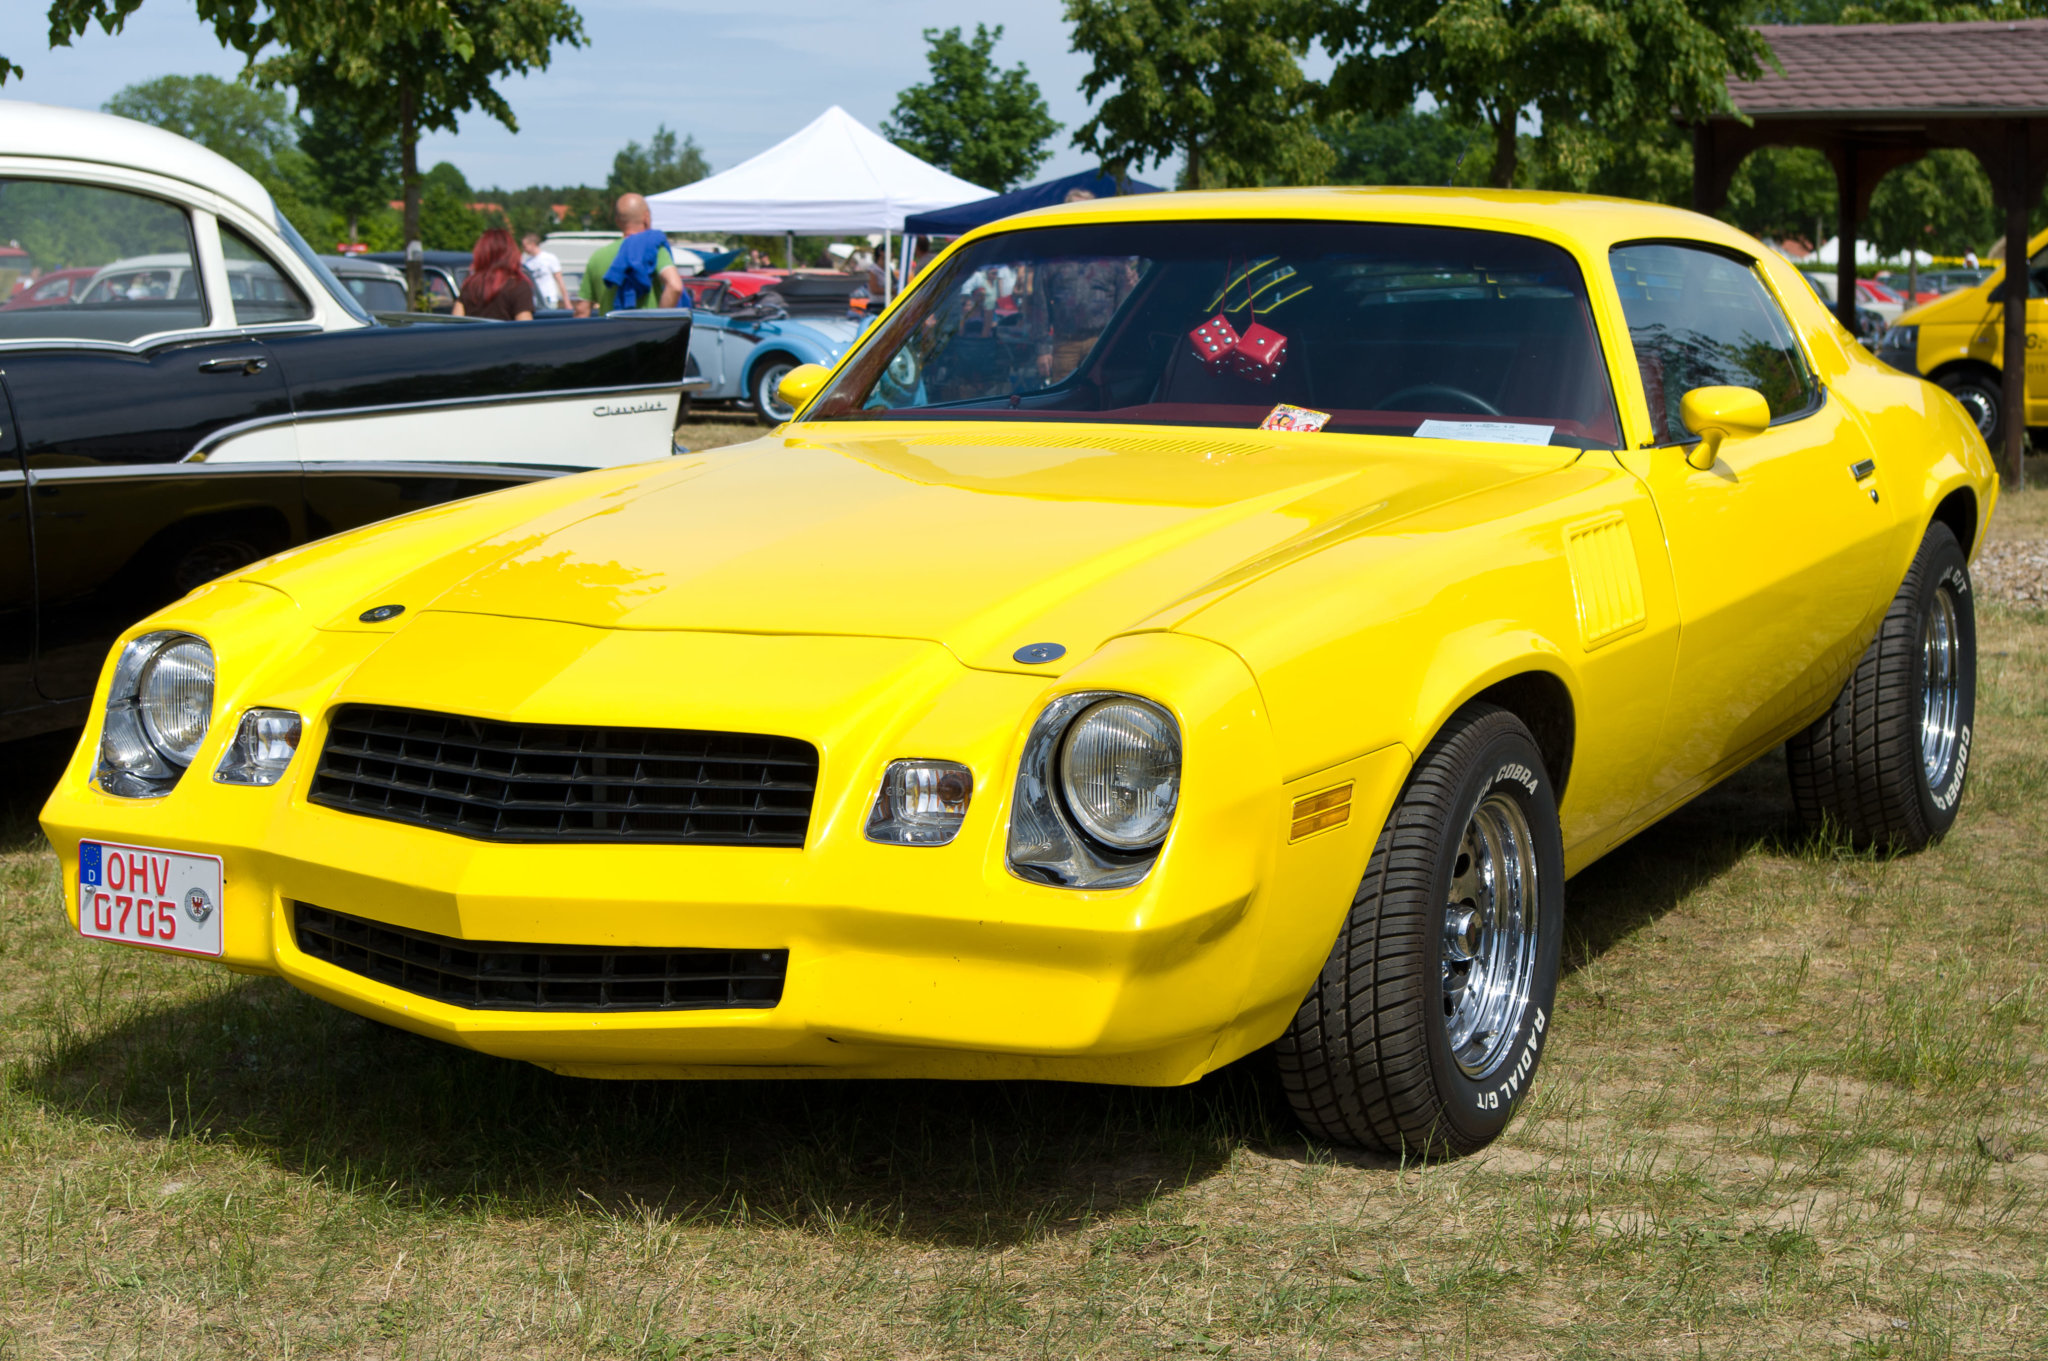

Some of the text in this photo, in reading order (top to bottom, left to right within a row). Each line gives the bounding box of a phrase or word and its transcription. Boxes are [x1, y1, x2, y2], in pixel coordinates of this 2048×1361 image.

[593, 401, 668, 417] Chevrolet
[1495, 763, 1539, 796] COBRA
[1944, 725, 1971, 808] COOPER
[88, 869, 97, 882] D
[107, 852, 170, 896] OHV
[94, 893, 176, 940] 0705
[1476, 1007, 1546, 1110] RADIAL G/T
